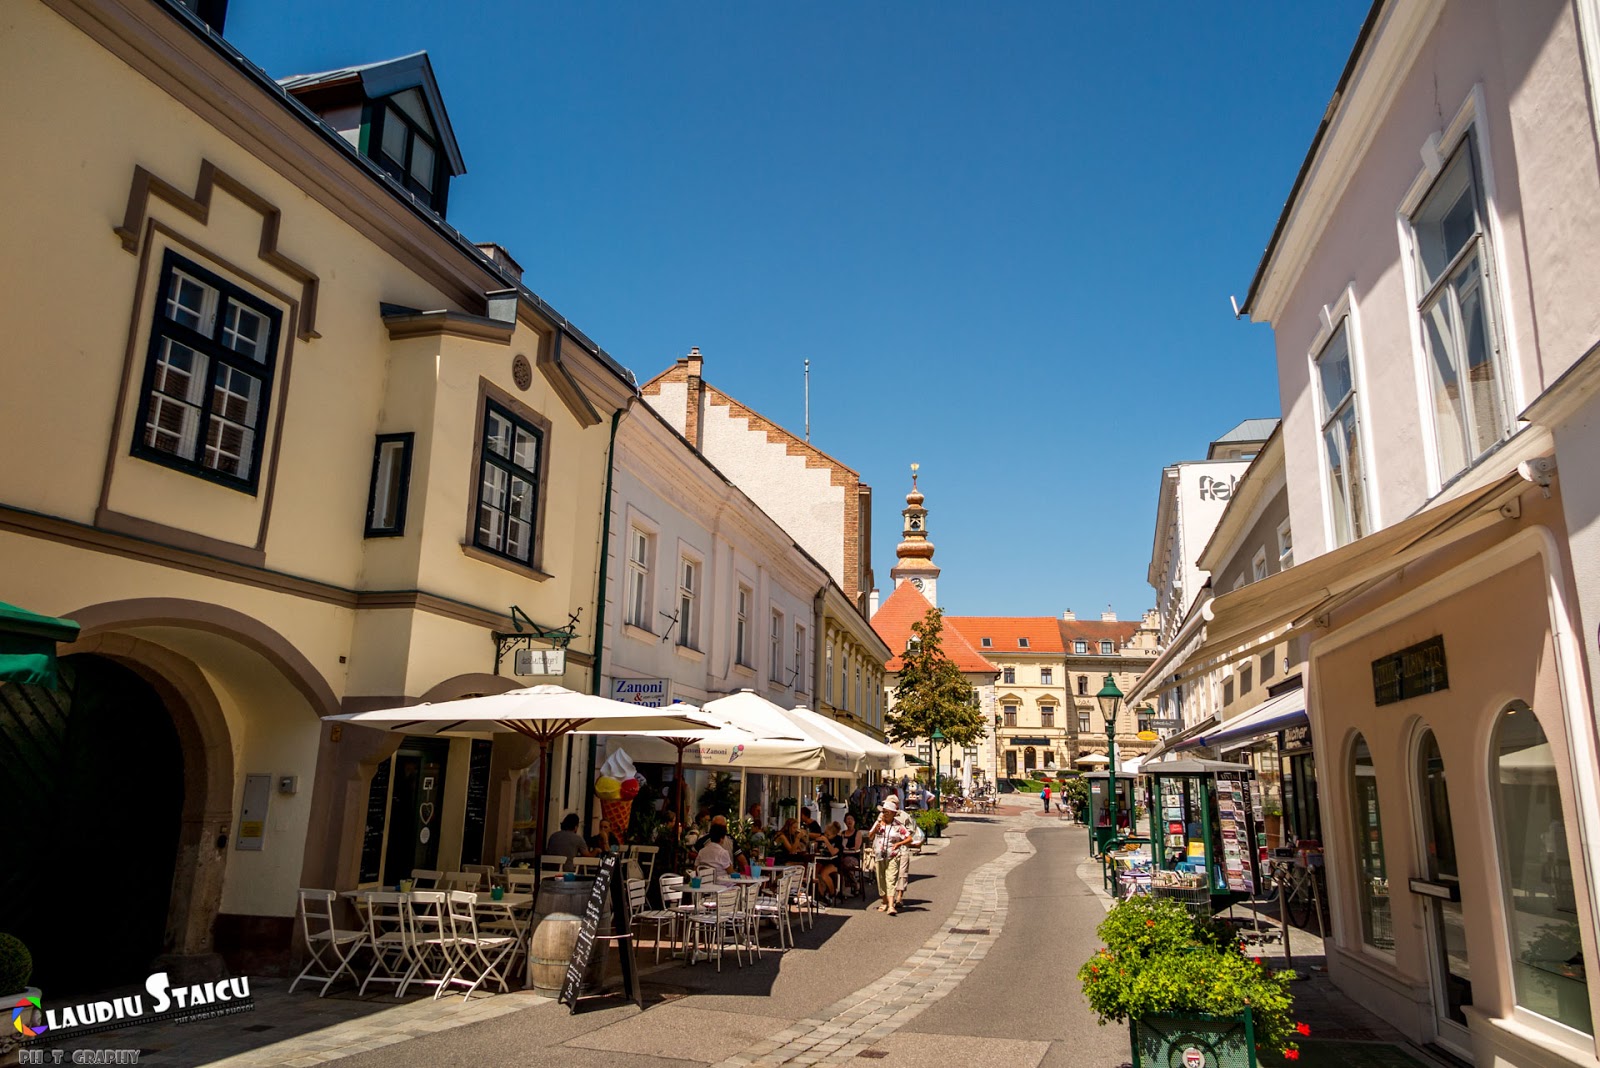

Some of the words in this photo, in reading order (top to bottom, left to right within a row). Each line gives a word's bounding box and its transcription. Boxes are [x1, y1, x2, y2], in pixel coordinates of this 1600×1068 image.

[1199, 474, 1240, 501] fiel
[616, 681, 662, 693] Zanoni
[634, 692, 642, 702] &
